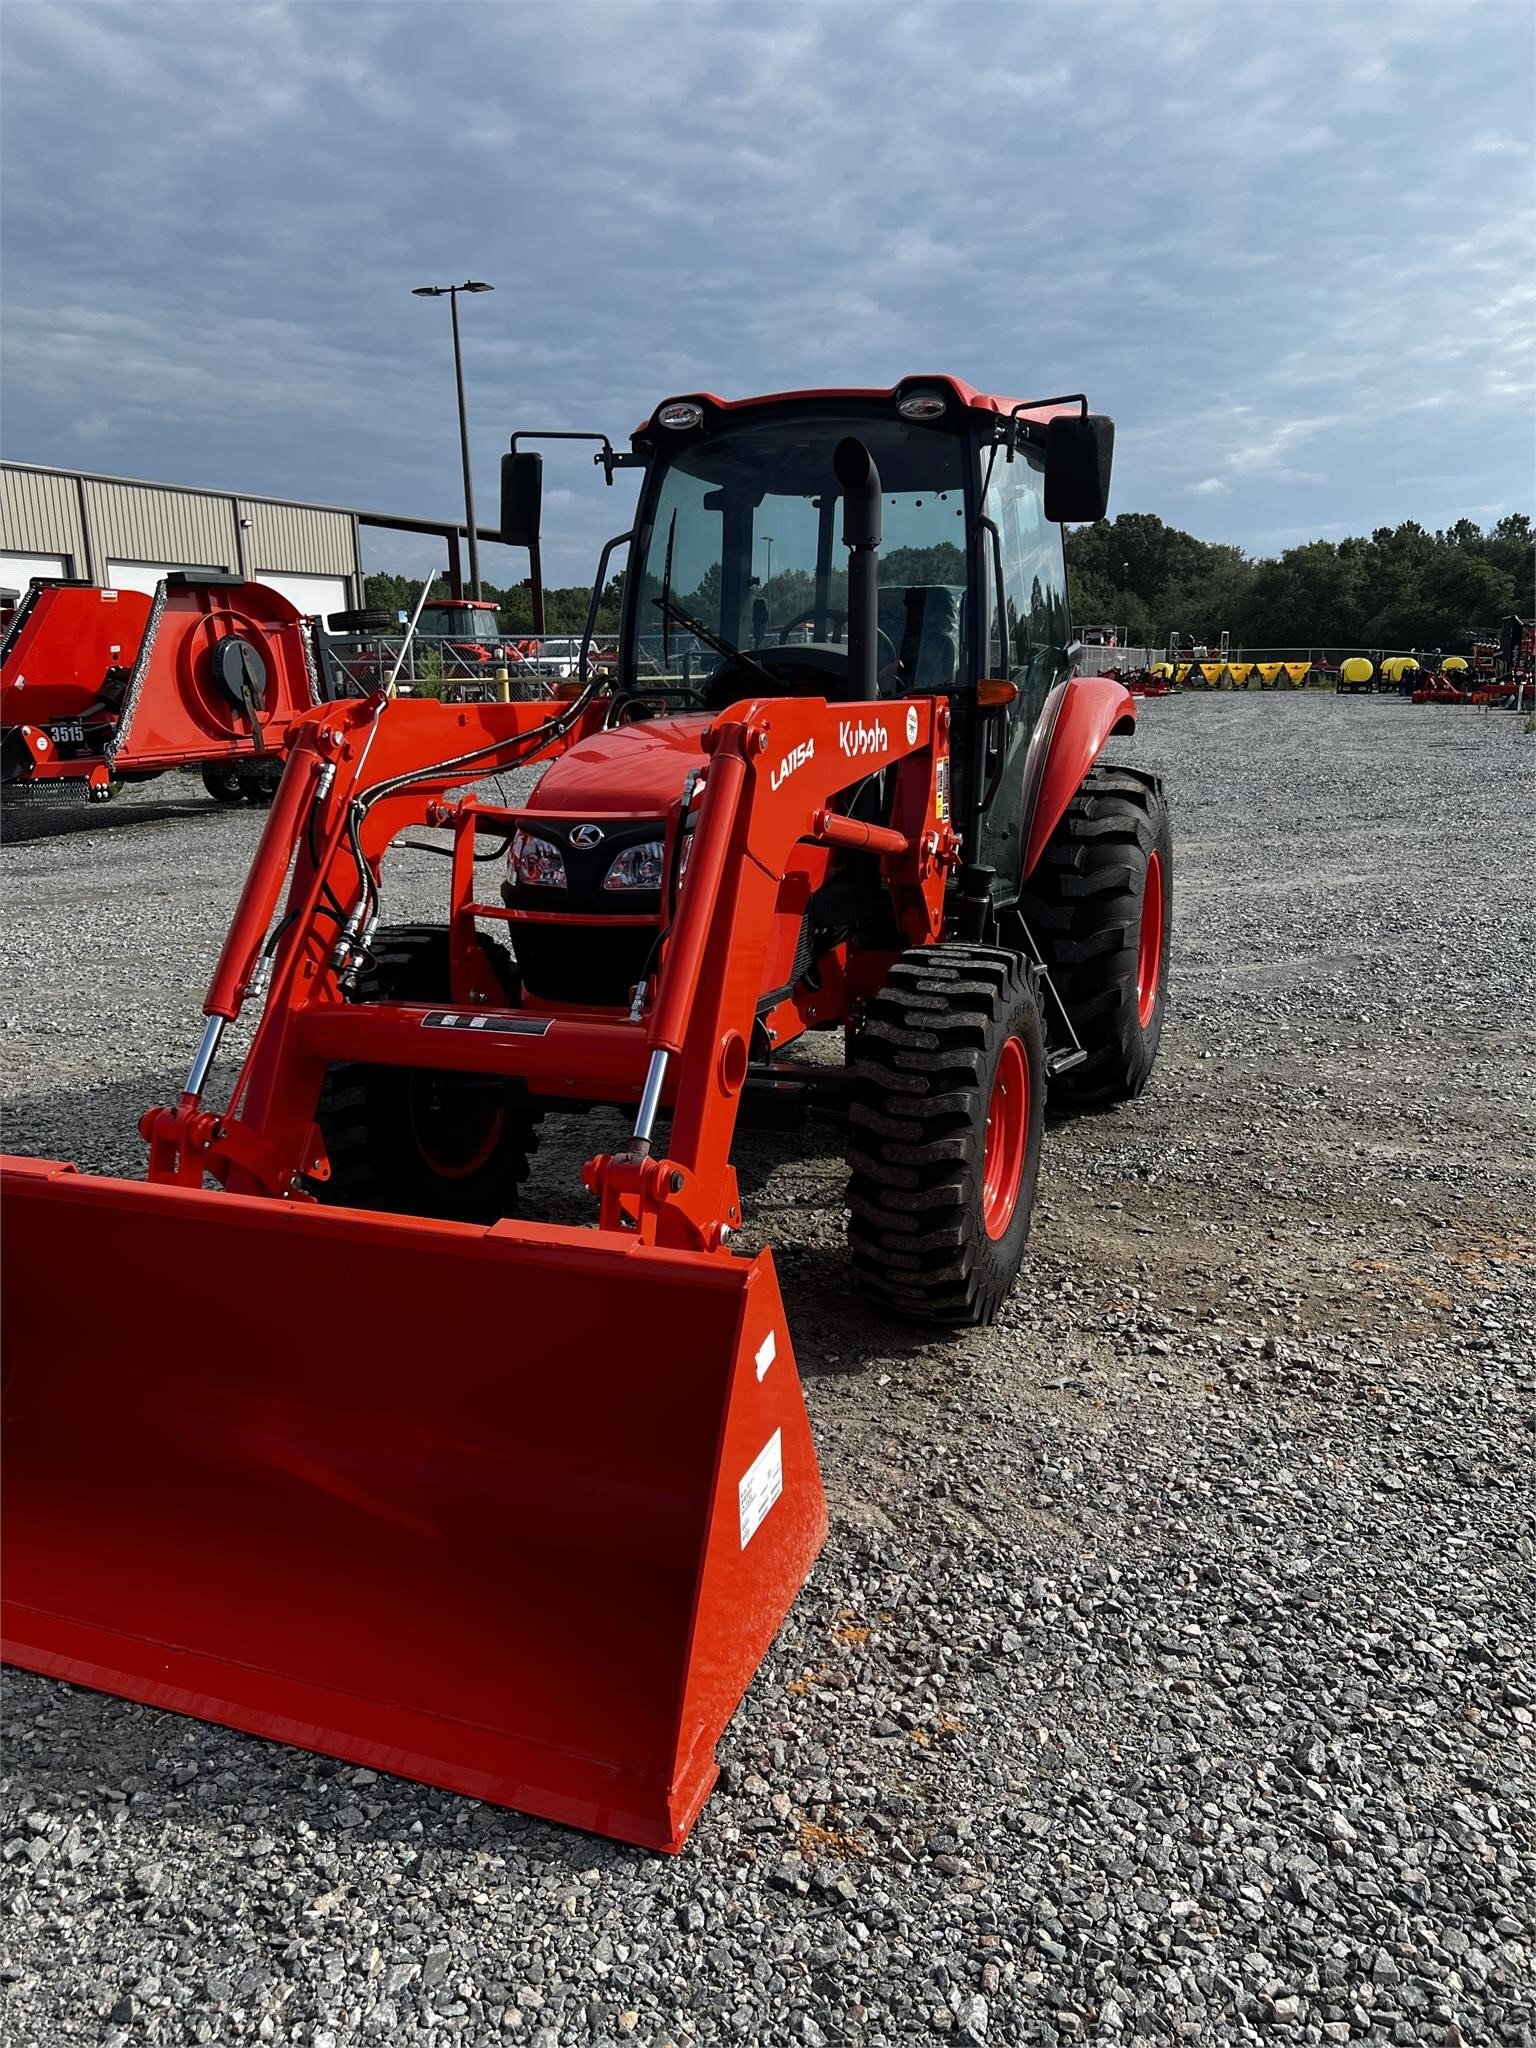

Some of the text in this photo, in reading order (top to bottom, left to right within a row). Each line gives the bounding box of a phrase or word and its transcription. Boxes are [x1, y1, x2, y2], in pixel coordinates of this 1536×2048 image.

[51, 726, 84, 742] 3515
[839, 718, 888, 757] Kubota
[770, 737, 815, 791] LA1154
